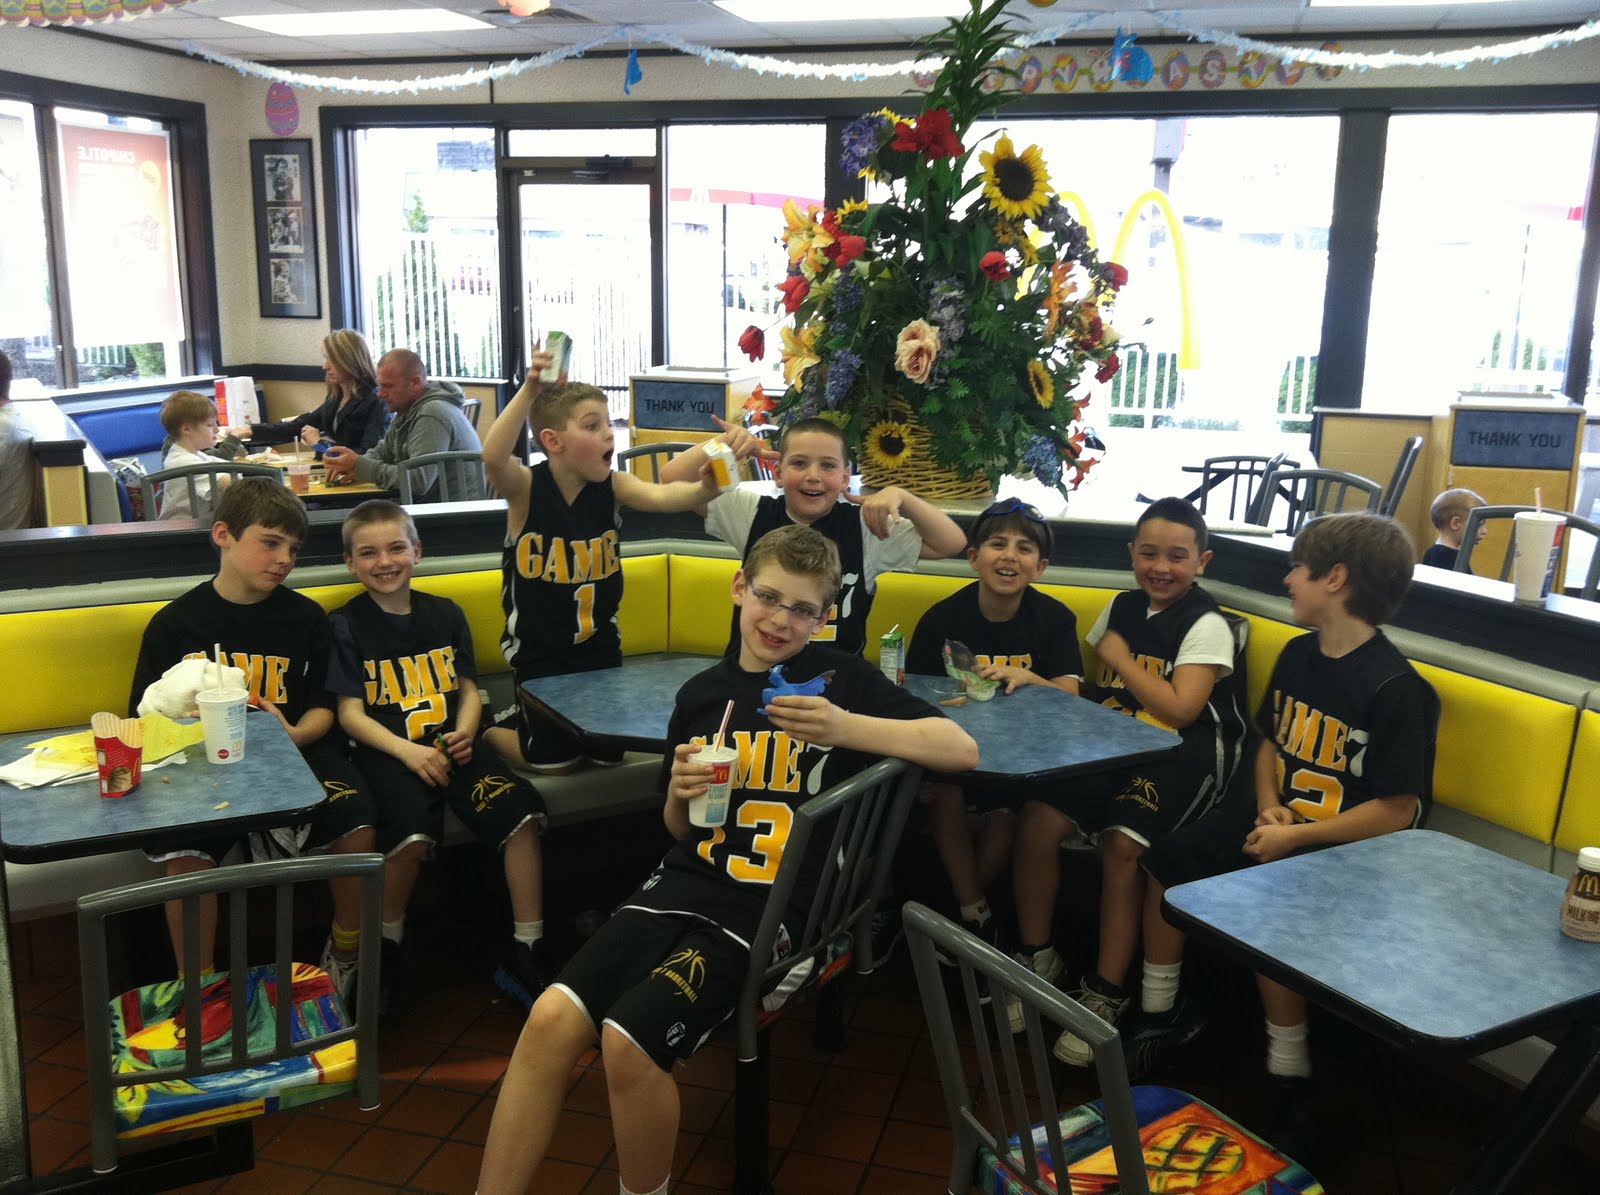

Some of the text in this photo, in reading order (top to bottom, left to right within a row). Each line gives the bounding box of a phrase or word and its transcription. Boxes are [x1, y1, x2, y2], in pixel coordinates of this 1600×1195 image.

[644, 399, 715, 414] THANK YOU
[1468, 430, 1561, 449] THANK YOU
[516, 529, 620, 584] GAME
[573, 583, 598, 645] 1
[182, 651, 290, 704] ME
[400, 693, 447, 741] 2
